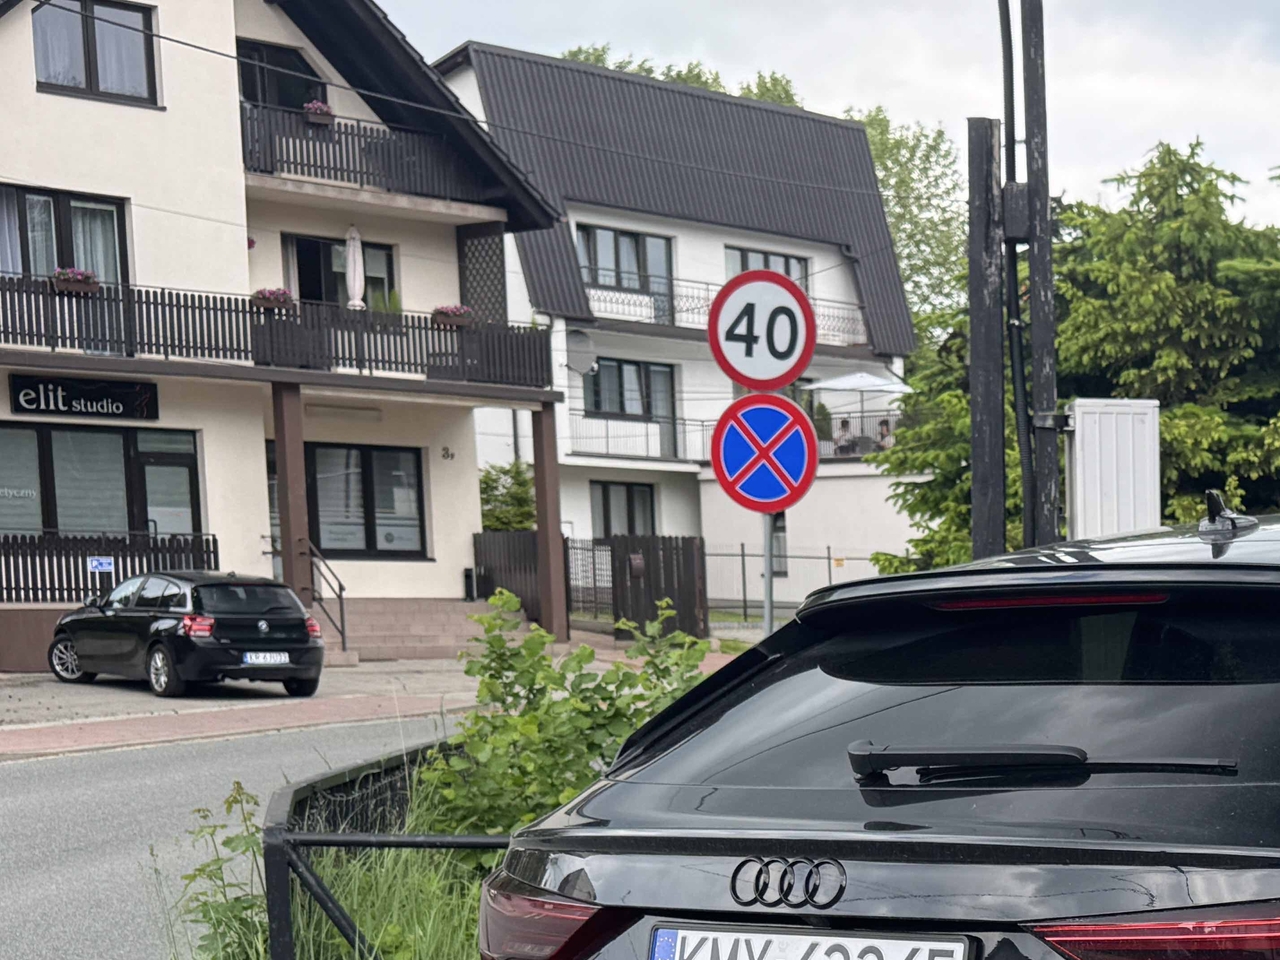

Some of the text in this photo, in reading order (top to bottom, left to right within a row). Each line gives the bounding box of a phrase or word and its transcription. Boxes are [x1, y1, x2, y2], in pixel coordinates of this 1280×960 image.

[725, 303, 798, 360] 40
[18, 384, 123, 414] elit studio
